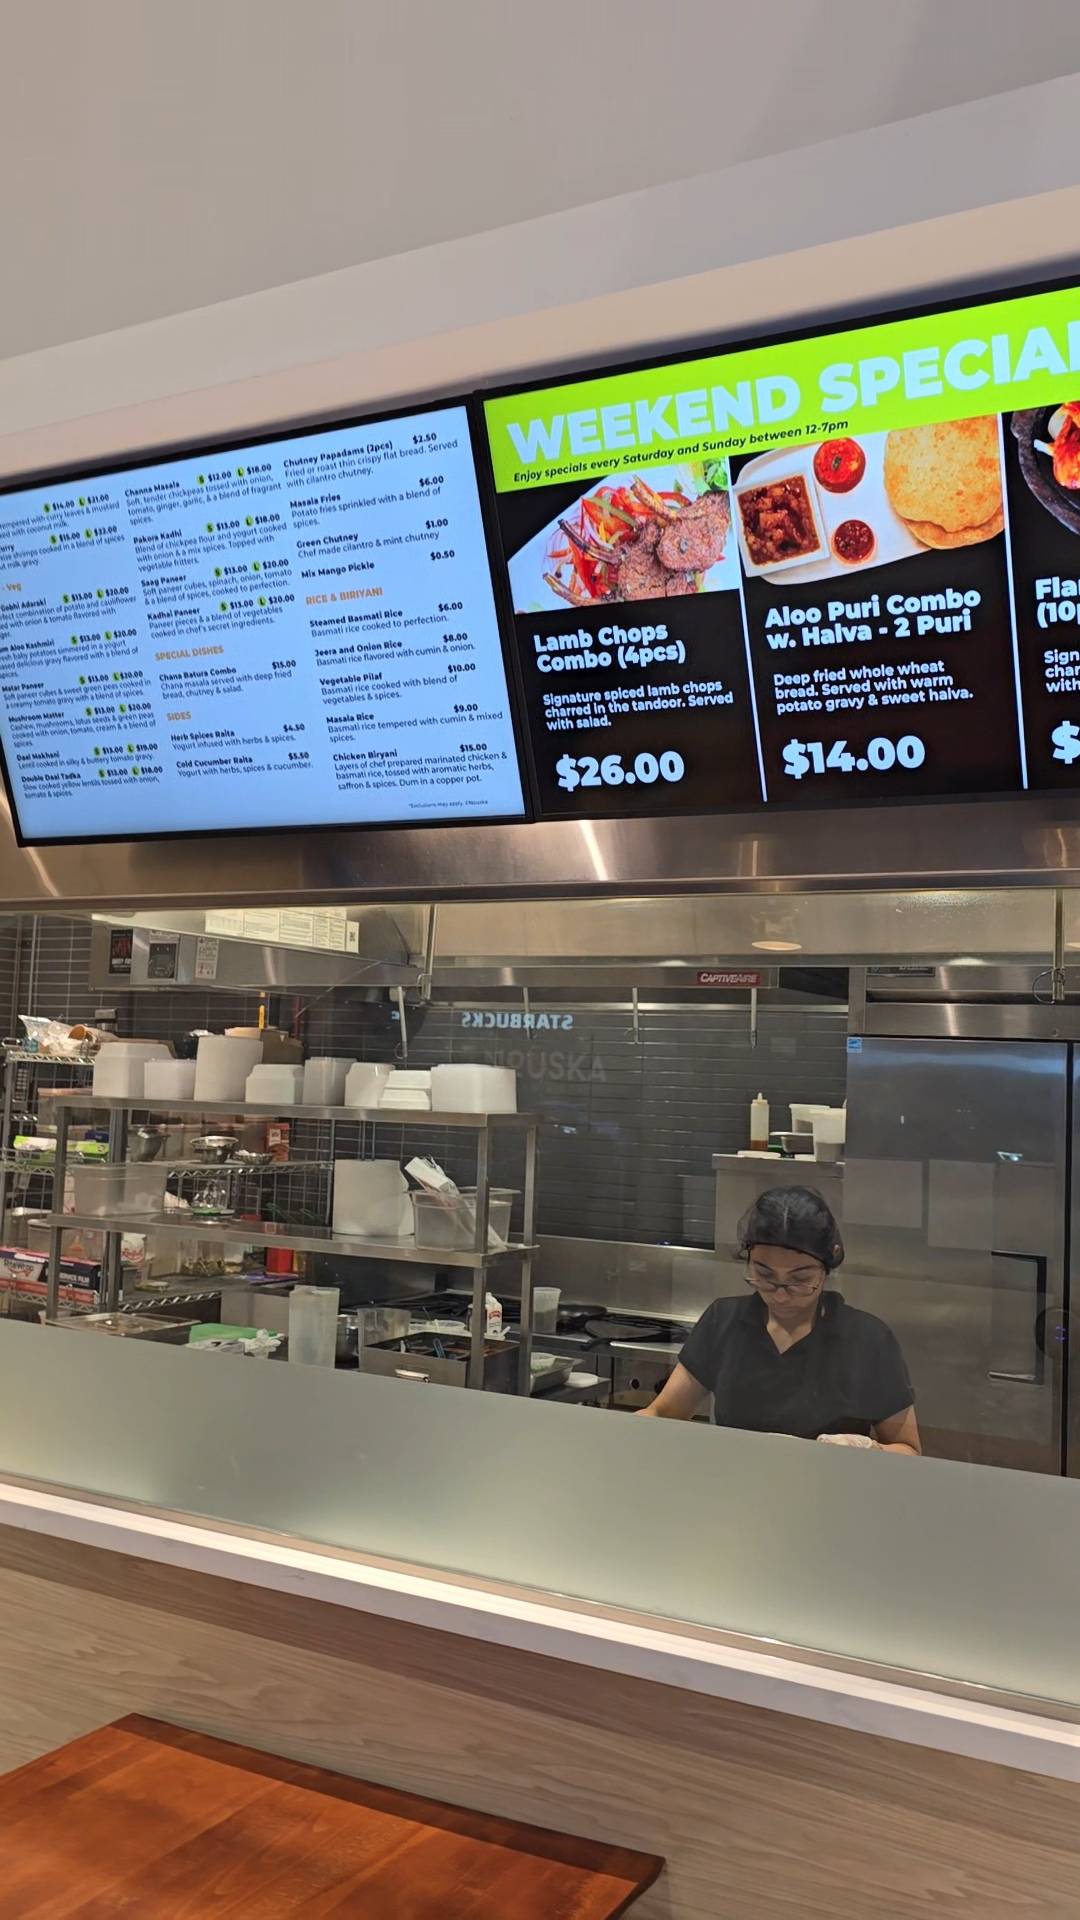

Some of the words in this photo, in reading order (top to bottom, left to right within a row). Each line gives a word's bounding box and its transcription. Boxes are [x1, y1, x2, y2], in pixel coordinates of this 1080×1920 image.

[506, 375, 802, 464] WEEKEND
[412, 433, 437, 444] $2.50
[283, 454, 318, 469] Chutney
[320, 446, 364, 463] Papadams
[366, 441, 393, 455] (2pcs)
[316, 461, 336, 472] roast
[338, 458, 355, 468] thin
[357, 453, 382, 466] crispy
[383, 451, 397, 460] flat
[427, 440, 458, 452] Served
[513, 468, 542, 484] Enjoy
[544, 462, 588, 478] specials
[591, 458, 620, 471] every
[623, 448, 674, 466] Saturday
[677, 443, 700, 456] and
[702, 437, 746, 454] Sunday
[749, 427, 802, 444] between
[805, 420, 849, 438] 12-7pm
[286, 477, 304, 487] with
[305, 472, 336, 484] cilantro
[419, 476, 444, 487] $6.00
[289, 496, 318, 508] Masala
[320, 493, 340, 503] Fries
[425, 519, 448, 529] $1.00
[296, 537, 321, 548] Green
[322, 531, 358, 546] Chutney
[297, 548, 316, 558] Chef
[318, 545, 341, 555] made
[342, 540, 373, 552] cilantro
[382, 536, 402, 546] mint
[404, 530, 439, 544] chutney
[430, 550, 454, 560] $0.50
[301, 569, 315, 578] Mix
[317, 564, 346, 577] Mango
[348, 561, 374, 572] Pickle
[305, 594, 327, 605] RICE
[339, 588, 382, 601] BIRIYANI
[438, 602, 462, 611] $6.00
[764, 606, 822, 627] Aloo
[828, 595, 880, 622] Puri
[886, 588, 980, 615] Combo
[309, 616, 345, 627] Steamed
[347, 612, 382, 623] Basmati
[384, 610, 402, 619] Rice
[443, 633, 467, 642] $8.00
[534, 629, 593, 652] Lamb
[598, 624, 668, 645] Chops
[766, 634, 796, 650] w.
[801, 622, 872, 646] Halva
[894, 620, 910, 638] 2
[917, 609, 971, 635] Puri
[314, 647, 336, 656] Jeera
[338, 645, 354, 654] and
[356, 642, 381, 652] Onion
[383, 640, 402, 649] Rice
[536, 650, 612, 672] Combo
[618, 640, 685, 669] (4pcs)
[447, 664, 475, 673] $10.00
[773, 672, 810, 689] Deep
[812, 669, 846, 683] fried
[849, 665, 894, 680] whole
[896, 661, 944, 676] wheat
[319, 675, 361, 687] Vegetable
[363, 673, 382, 682] Pilaf
[774, 684, 818, 699] bread.
[821, 680, 870, 695] Served
[873, 677, 906, 691] with
[910, 676, 953, 688] warm
[1046, 677, 1080, 692] with
[542, 690, 601, 706] Signature
[603, 687, 644, 701] spiced
[647, 684, 680, 697] lamb
[682, 681, 722, 694] chops
[776, 698, 822, 715] potato
[825, 698, 864, 712] gravy
[867, 694, 878, 706] &
[881, 691, 925, 705] sweet
[928, 687, 973, 702] halva.
[453, 704, 477, 713] $9.00
[544, 703, 591, 718] charred
[593, 702, 605, 714] in
[607, 700, 629, 713] the
[631, 696, 685, 711] tandoor.
[687, 692, 733, 706] Served
[326, 714, 354, 723] Masala
[356, 713, 374, 721] Rice
[546, 718, 573, 730] with
[576, 715, 611, 728] salad.
[332, 752, 365, 761] Chicken
[367, 750, 397, 760] Biryani
[459, 744, 487, 752] $15.00
[782, 735, 926, 780] $14.00
[556, 750, 685, 792] $26.00
